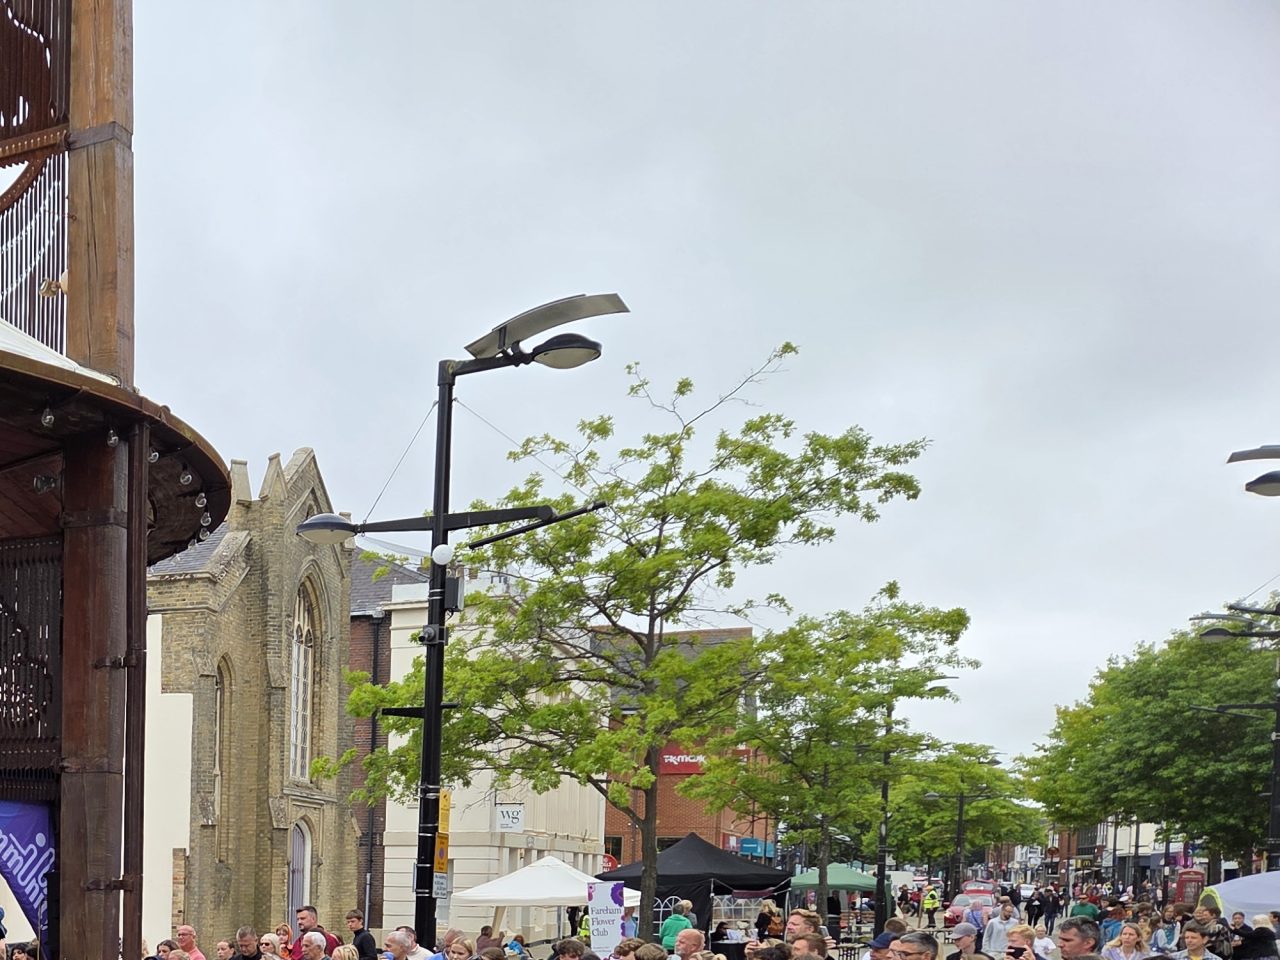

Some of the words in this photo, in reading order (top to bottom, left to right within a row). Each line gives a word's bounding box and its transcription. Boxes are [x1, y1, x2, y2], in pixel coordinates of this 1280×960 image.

[590, 906, 622, 916] Fareham
[591, 918, 616, 926] Flower
[592, 928, 609, 937] Club
